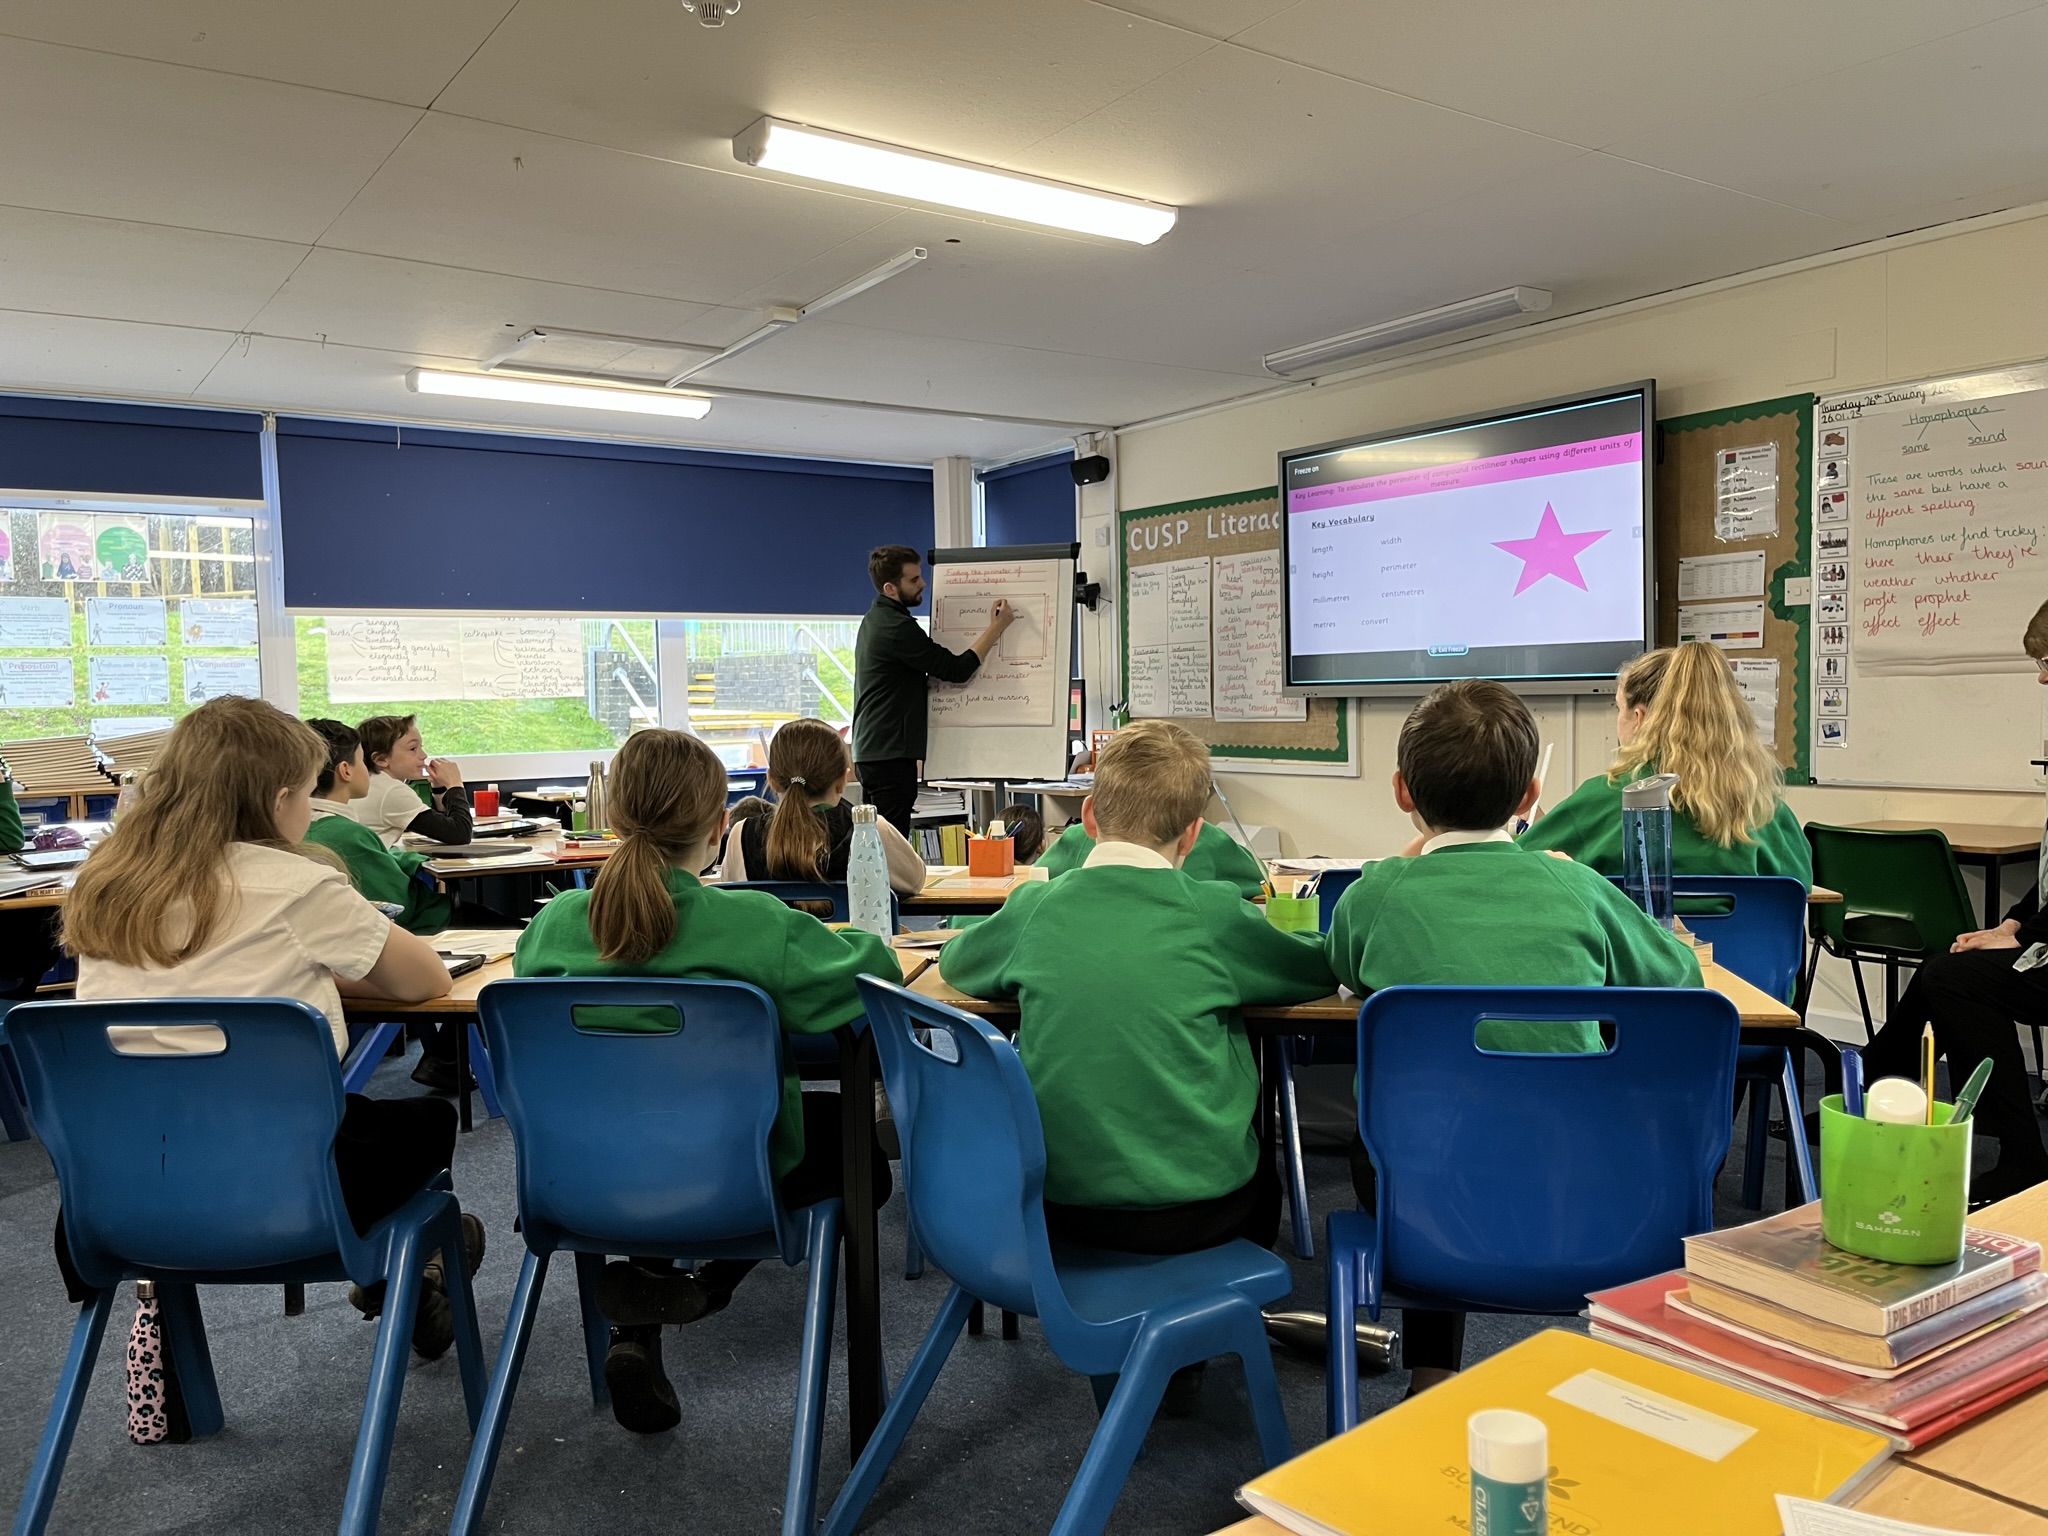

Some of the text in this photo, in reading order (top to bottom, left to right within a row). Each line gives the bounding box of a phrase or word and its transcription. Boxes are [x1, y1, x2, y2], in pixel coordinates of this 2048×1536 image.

[1820, 400, 1862, 414] Thursday
[1884, 389, 1926, 404] January
[1908, 404, 1990, 424] Homophones
[1968, 429, 2007, 446] sound
[1902, 444, 1930, 455] same
[1294, 465, 1320, 476] Freeze on
[1346, 480, 1374, 492] calculate
[1388, 474, 1420, 486] perimeter
[1423, 472, 1430, 480] of
[1432, 466, 1468, 478] compound
[1471, 460, 1508, 472] rectilinear
[1510, 454, 1536, 466] shapes
[1538, 452, 1560, 462] using
[1563, 445, 1596, 458] different
[1600, 442, 1620, 451] units
[1624, 438, 1633, 448] of
[1866, 460, 2048, 486] These are words which soun
[1430, 478, 1461, 488] measure.
[1866, 481, 2008, 503] the same but have a
[1866, 499, 1976, 528] different spelling
[1312, 514, 1374, 529] Key Vocabulary
[1130, 511, 1280, 552] CUSP Literac
[1865, 534, 1934, 550] Homophones
[1940, 533, 1958, 542] we
[1960, 526, 1988, 550] find
[1380, 536, 1402, 546] width
[1312, 545, 1334, 555] length
[1865, 544, 2038, 569] there their they're
[984, 568, 1011, 578] perimeter
[1312, 570, 1334, 580] height
[1380, 562, 1418, 574] perimeter
[1864, 572, 1999, 588] weather whether
[1312, 594, 1350, 604] millimetres
[1382, 588, 1424, 598] centimetres
[108, 602, 144, 610] Pronoun
[1864, 589, 1972, 616] profit prophet
[1362, 618, 1388, 626] convert
[1862, 611, 1960, 636] affect effect
[198, 661, 246, 669] Conjunction
[998, 695, 1030, 705] missing
[1856, 1221, 1920, 1236] SAHARAN
[1892, 1287, 1951, 1330] PIG HEART BOY
